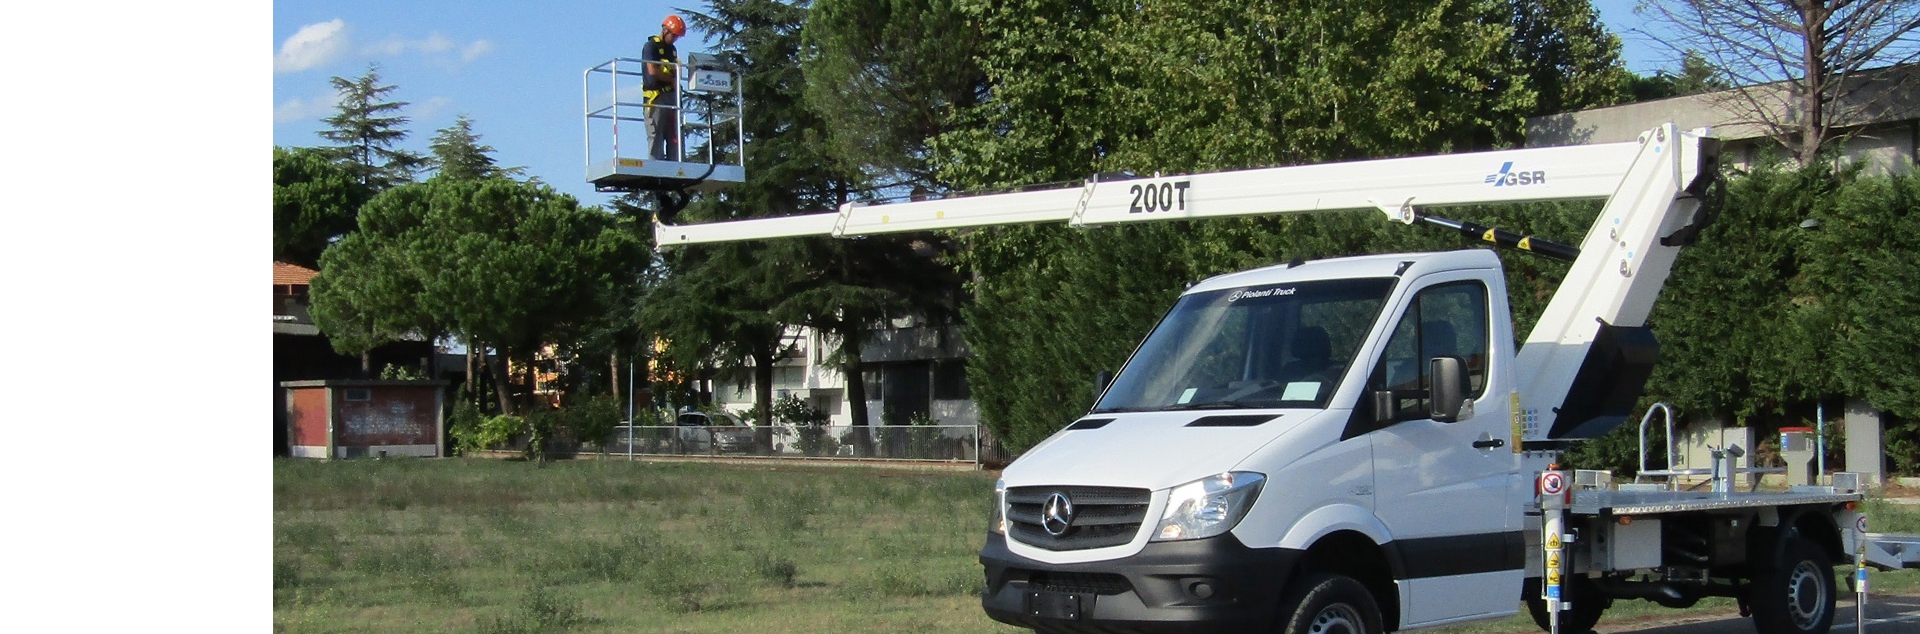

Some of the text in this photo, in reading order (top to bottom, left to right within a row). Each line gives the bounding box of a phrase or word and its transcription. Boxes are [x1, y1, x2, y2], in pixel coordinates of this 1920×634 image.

[1505, 171, 1545, 186] GSR
[1129, 181, 1190, 213] 200T
[1273, 287, 1296, 296] Truck
